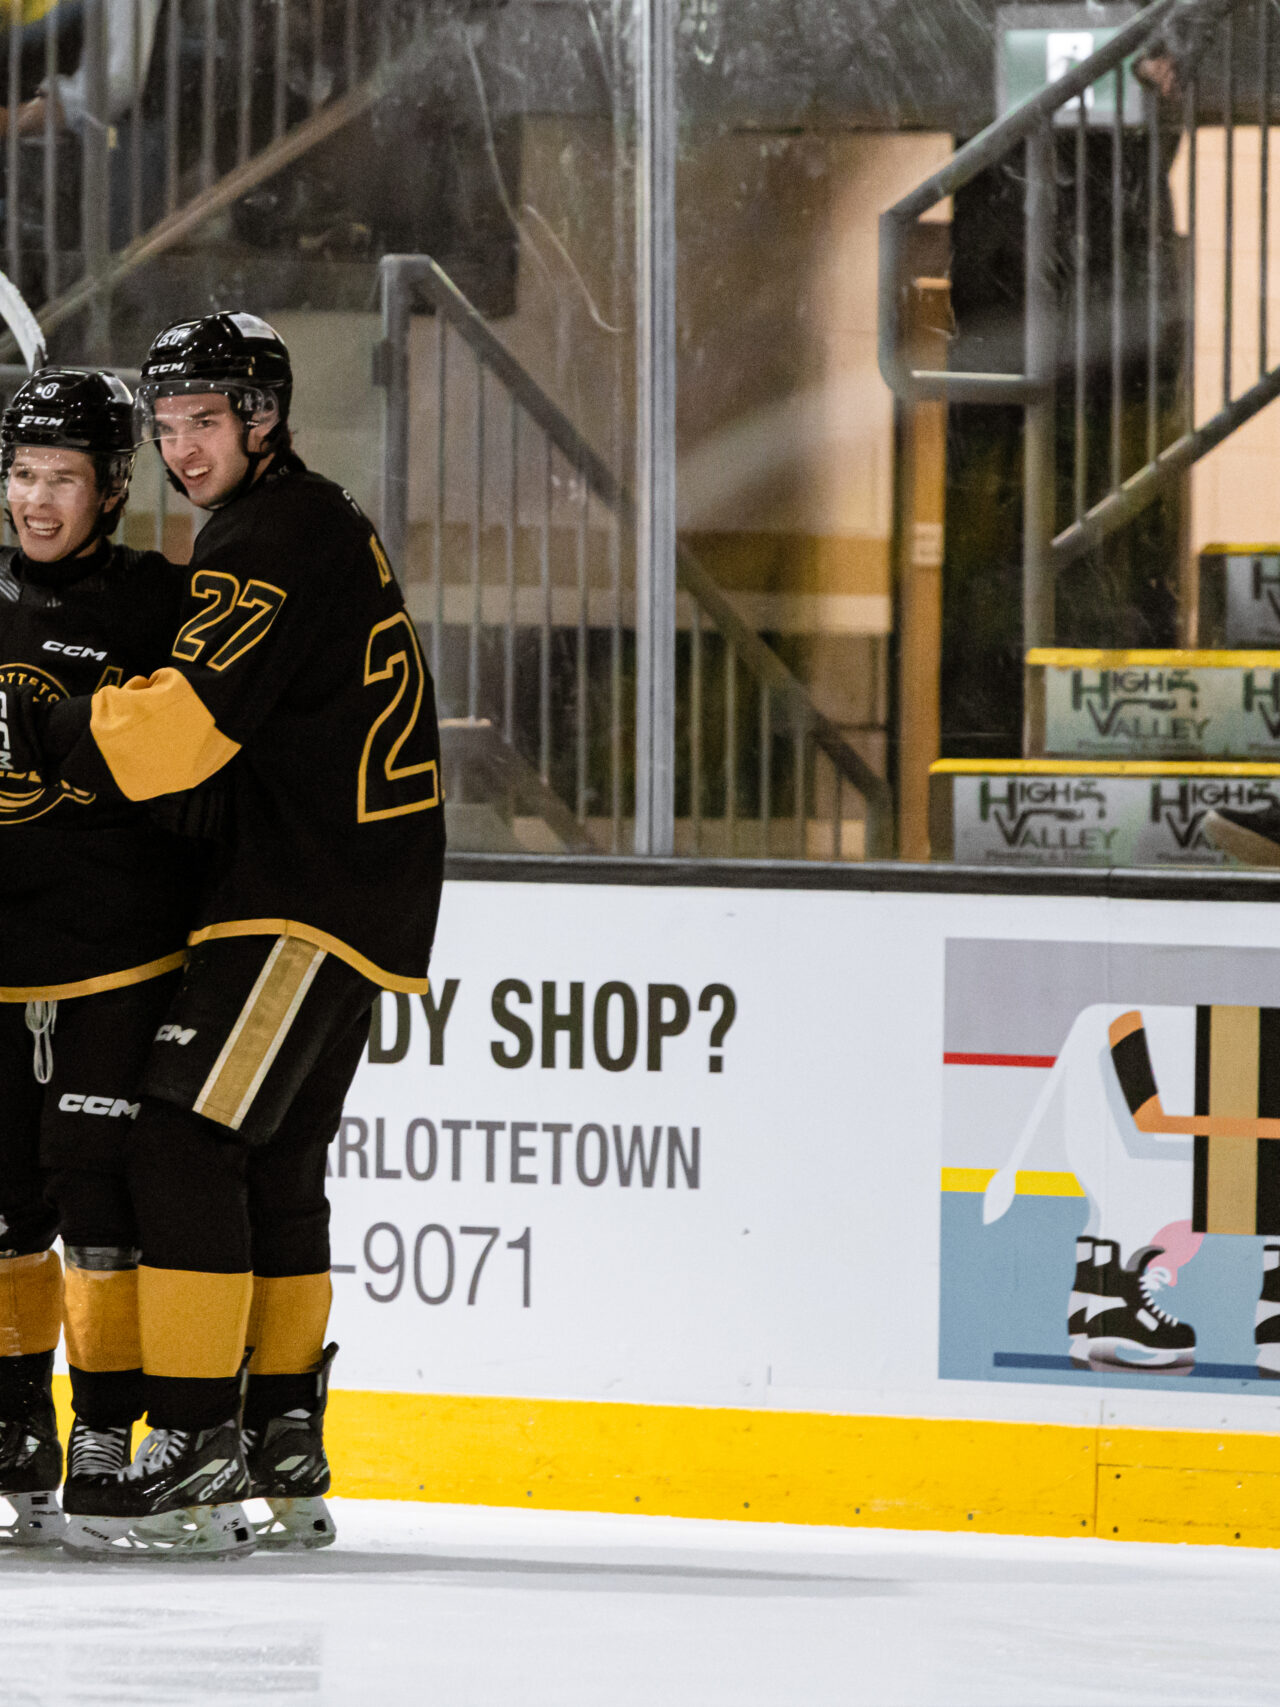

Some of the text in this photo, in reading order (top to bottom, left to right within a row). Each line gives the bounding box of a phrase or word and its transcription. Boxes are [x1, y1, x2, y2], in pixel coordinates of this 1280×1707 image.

[147, 362, 185, 376] CCM
[20, 415, 65, 427] CCM
[171, 569, 288, 672] 27
[42, 640, 107, 661] CCM
[1072, 670, 1164, 711] HIGH
[1086, 699, 1210, 738] VALLEY
[979, 780, 1070, 822] HIGH
[994, 809, 1119, 849] VALLEY
[153, 1024, 198, 1046] CM
[490, 977, 738, 1074] SHOP?
[58, 1092, 142, 1120] CCM
[199, 1459, 240, 1502] CCM
